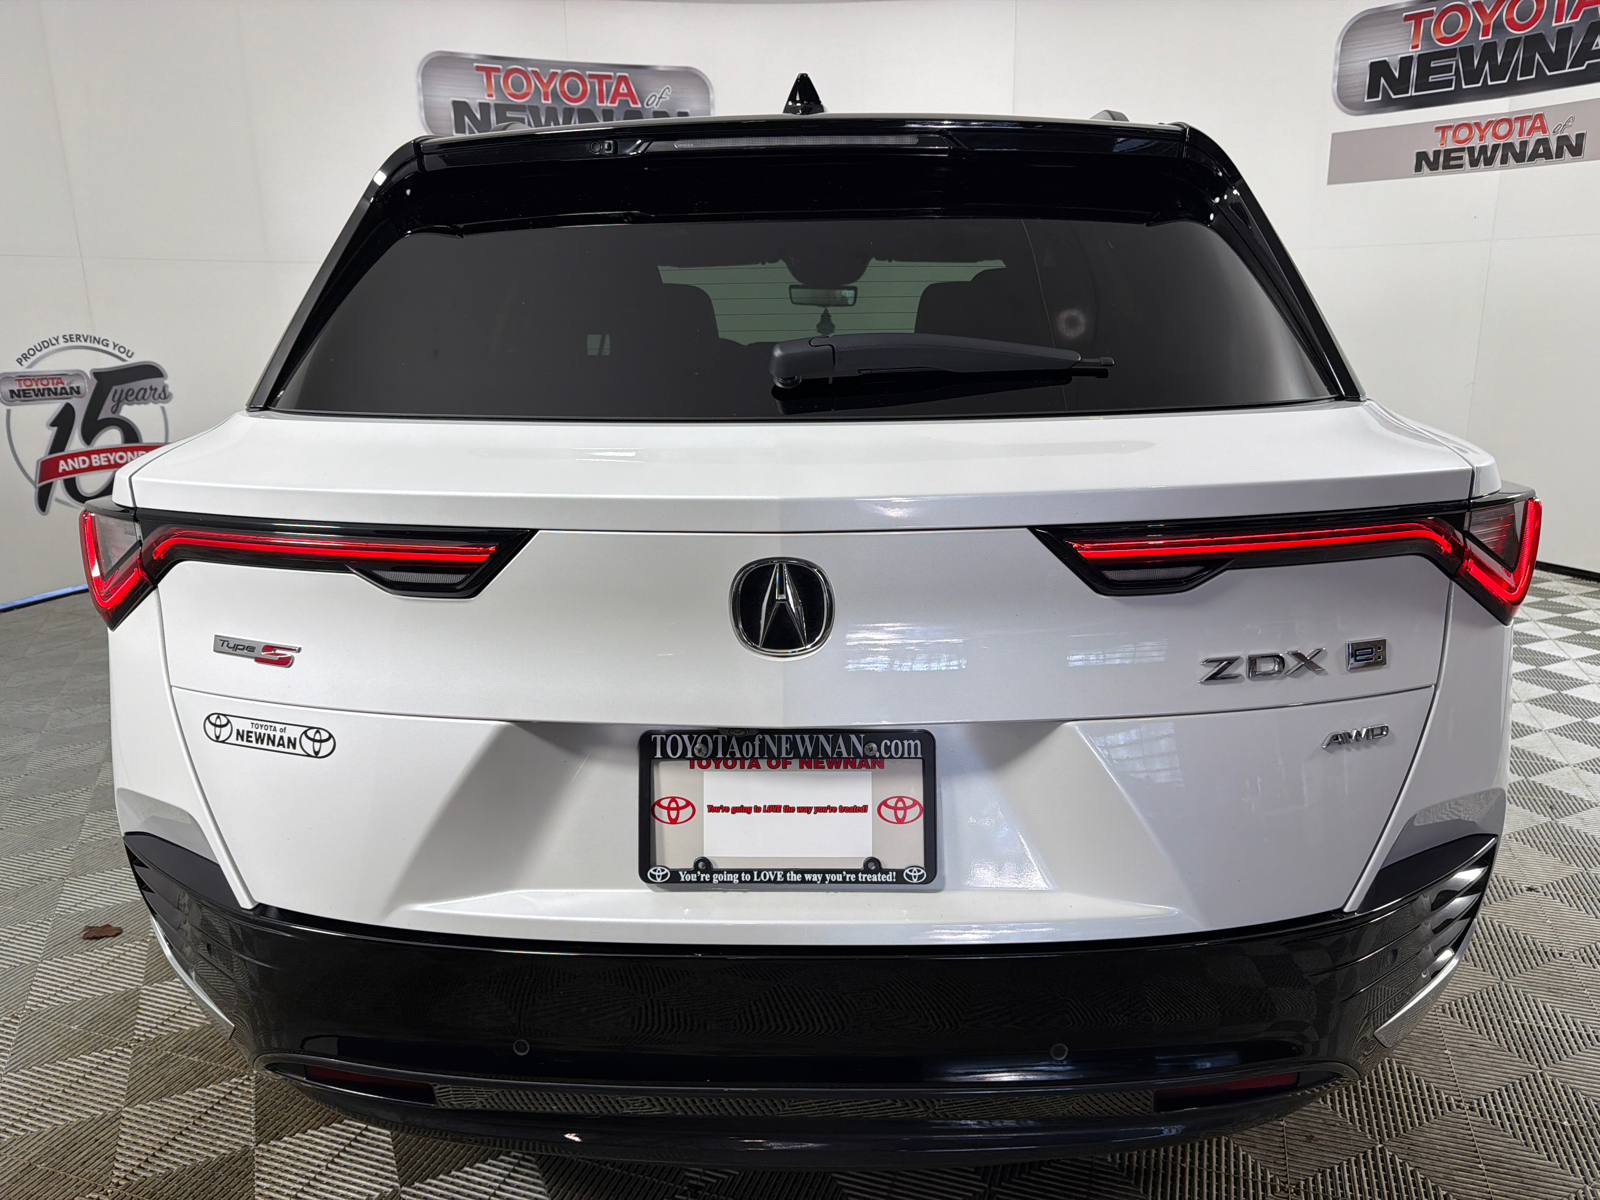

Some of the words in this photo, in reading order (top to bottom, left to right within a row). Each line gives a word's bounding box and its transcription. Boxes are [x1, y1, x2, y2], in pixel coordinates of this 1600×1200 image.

[474, 65, 641, 107] TOYOTA
[645, 86, 671, 108] of
[1435, 113, 1548, 147] TOYOTA
[1552, 116, 1575, 134] of
[1414, 132, 1586, 174] NEWNAN
[15, 335, 60, 367] PROUDLY
[62, 333, 109, 347] SERVING
[112, 341, 135, 359] YOU
[9, 386, 80, 399] NEWNAN
[15, 377, 65, 388] TOYOTA
[111, 384, 171, 415] years
[58, 454, 91, 473] AND
[218, 639, 256, 653] Type
[254, 645, 302, 668] S
[1198, 648, 1326, 683] ZDX
[236, 728, 297, 750] NEWNAN
[250, 722, 277, 733] TOYOTA
[1321, 724, 1389, 749] AWD
[688, 758, 761, 770] TOYOTA
[767, 758, 792, 770] OF
[799, 758, 884, 770] NEWNAN
[731, 805, 752, 814] going
[754, 805, 761, 813] to
[763, 805, 782, 813] LOVE
[783, 805, 795, 813] the
[797, 806, 812, 814] way
[838, 805, 868, 813] treated!
[712, 872, 739, 883] going
[741, 872, 751, 882] to
[753, 871, 784, 882] LOVE
[786, 871, 802, 882] the
[804, 873, 823, 884] way
[858, 871, 896, 882] treated!
